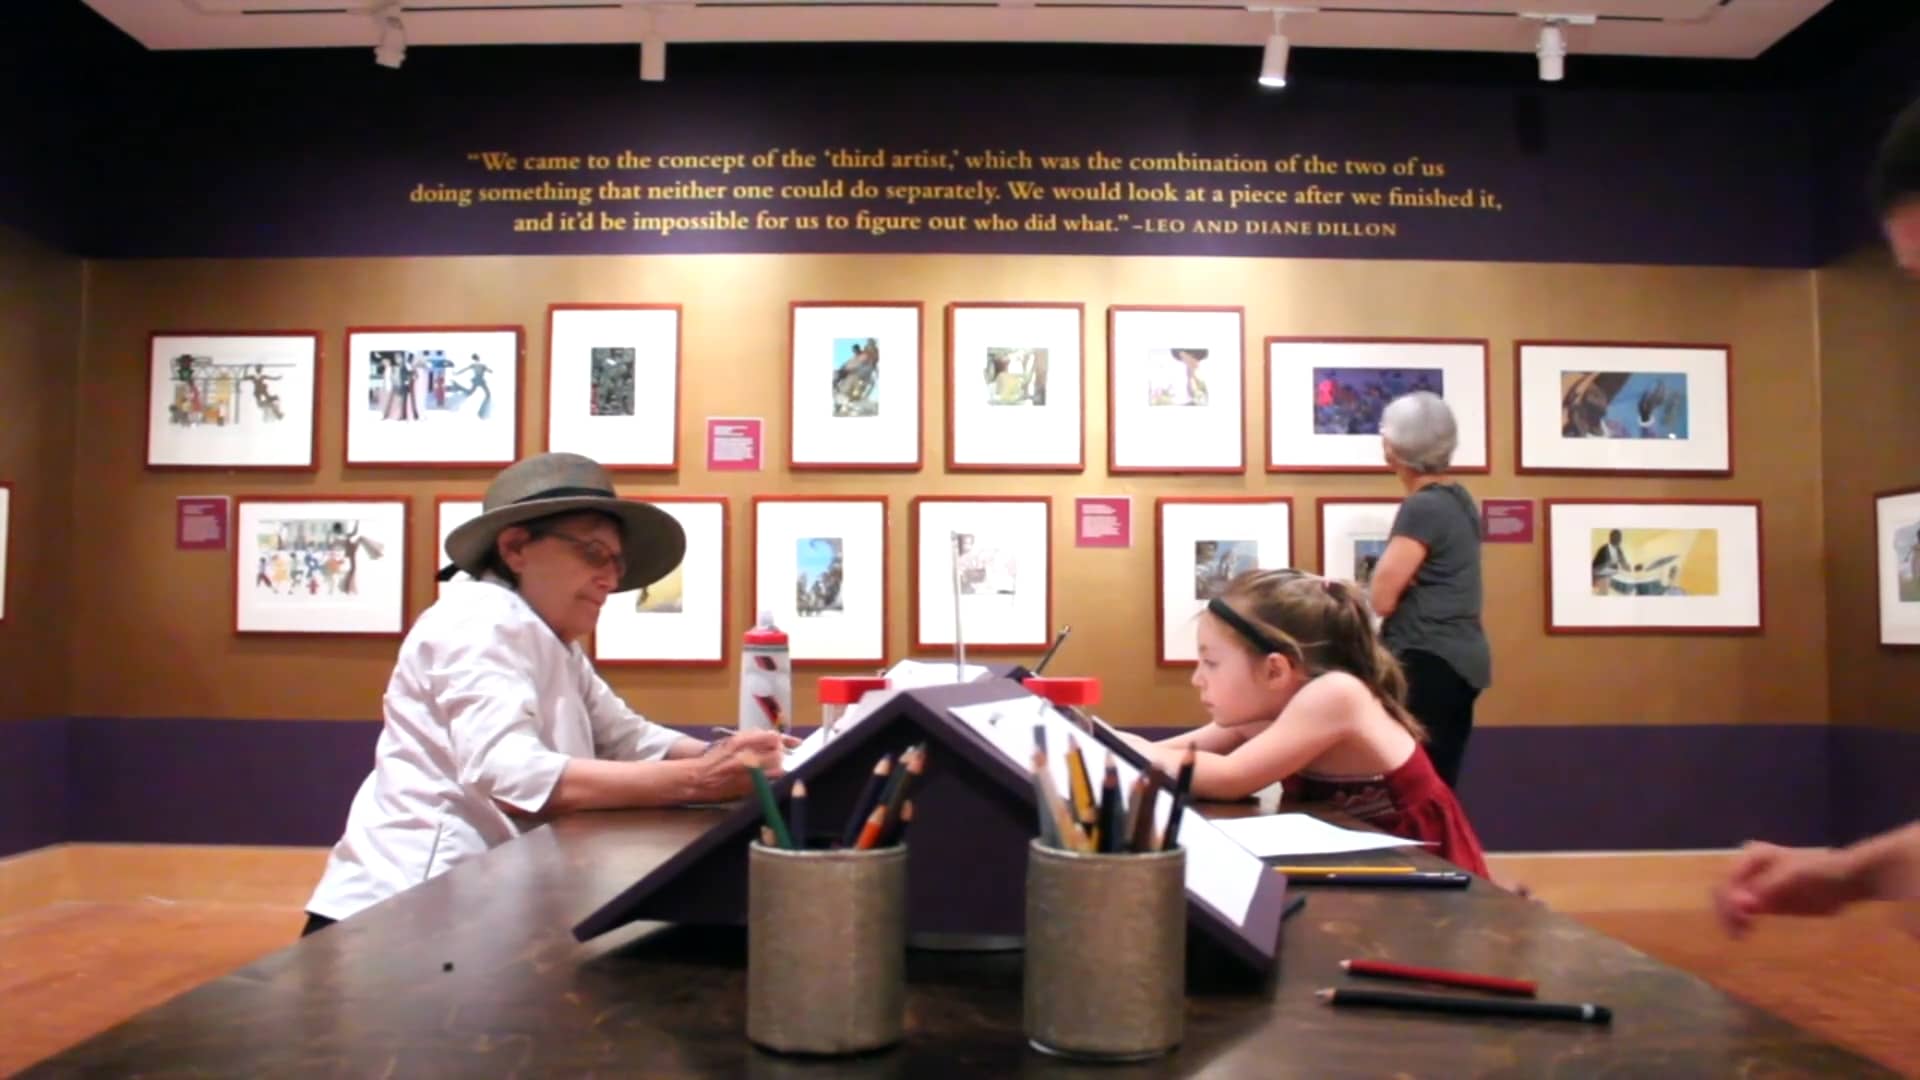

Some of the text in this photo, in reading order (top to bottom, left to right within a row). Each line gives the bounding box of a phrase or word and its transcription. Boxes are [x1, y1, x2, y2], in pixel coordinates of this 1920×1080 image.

[523, 157, 580, 169] came
[587, 156, 610, 169] to
[616, 150, 651, 168] the
[658, 154, 745, 174] concept
[751, 149, 778, 167] of
[781, 149, 816, 167] the
[965, 150, 1032, 168] which
[1040, 157, 1080, 169] was
[1087, 151, 1123, 170] the
[1129, 152, 1268, 172] combination
[1275, 154, 1301, 172] of
[1303, 155, 1338, 174] the
[1345, 161, 1387, 174] two
[1393, 157, 1418, 175] of
[1422, 164, 1445, 176] us
[409, 180, 1503, 210] doing something that neither one could do separately. We would look at a piece after we finished it,
[513, 212, 553, 231] and
[600, 211, 626, 230] be
[633, 210, 749, 235] impossible
[756, 210, 788, 229] for
[795, 217, 819, 229] us
[826, 215, 849, 229] to
[856, 210, 921, 235] figure
[928, 216, 966, 230] out
[973, 214, 1018, 230] who
[1024, 214, 1057, 231] did
[1192, 220, 1239, 233] AND
[1246, 221, 1312, 234] DIANE
[1317, 222, 1397, 236] DILLON
